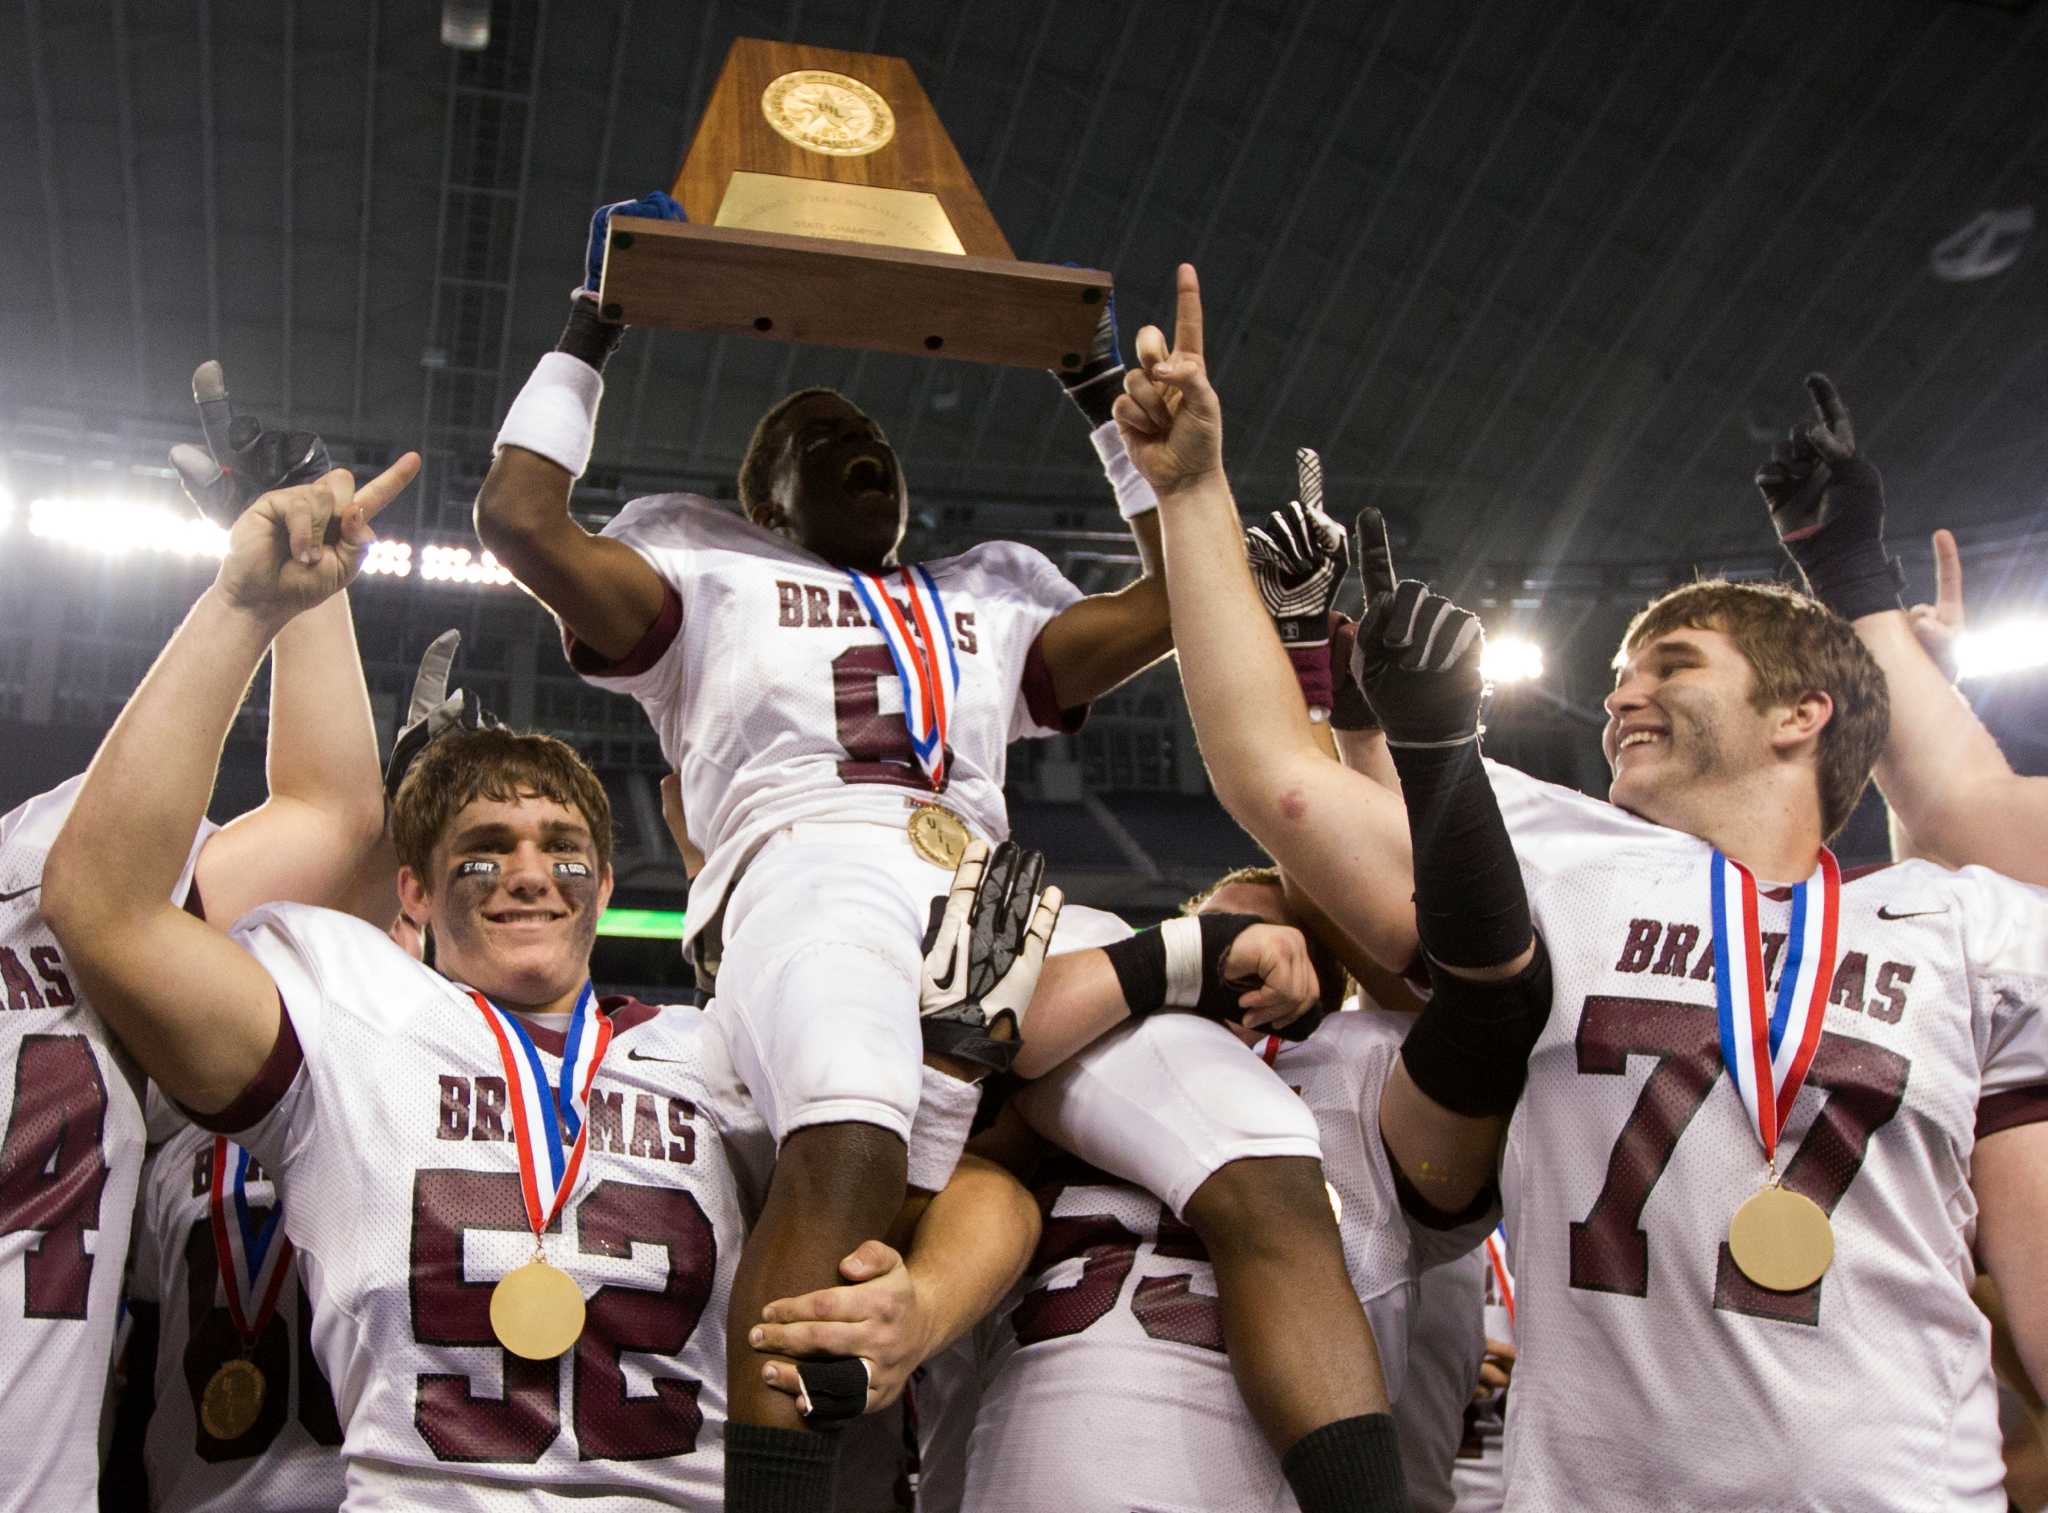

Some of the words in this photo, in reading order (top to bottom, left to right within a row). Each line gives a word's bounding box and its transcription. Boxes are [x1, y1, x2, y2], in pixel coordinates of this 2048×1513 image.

[0, 946, 76, 1010] AS
[437, 1074, 696, 1165] BRMAS
[1569, 995, 1912, 1327] 77
[409, 1168, 717, 1464] 52
